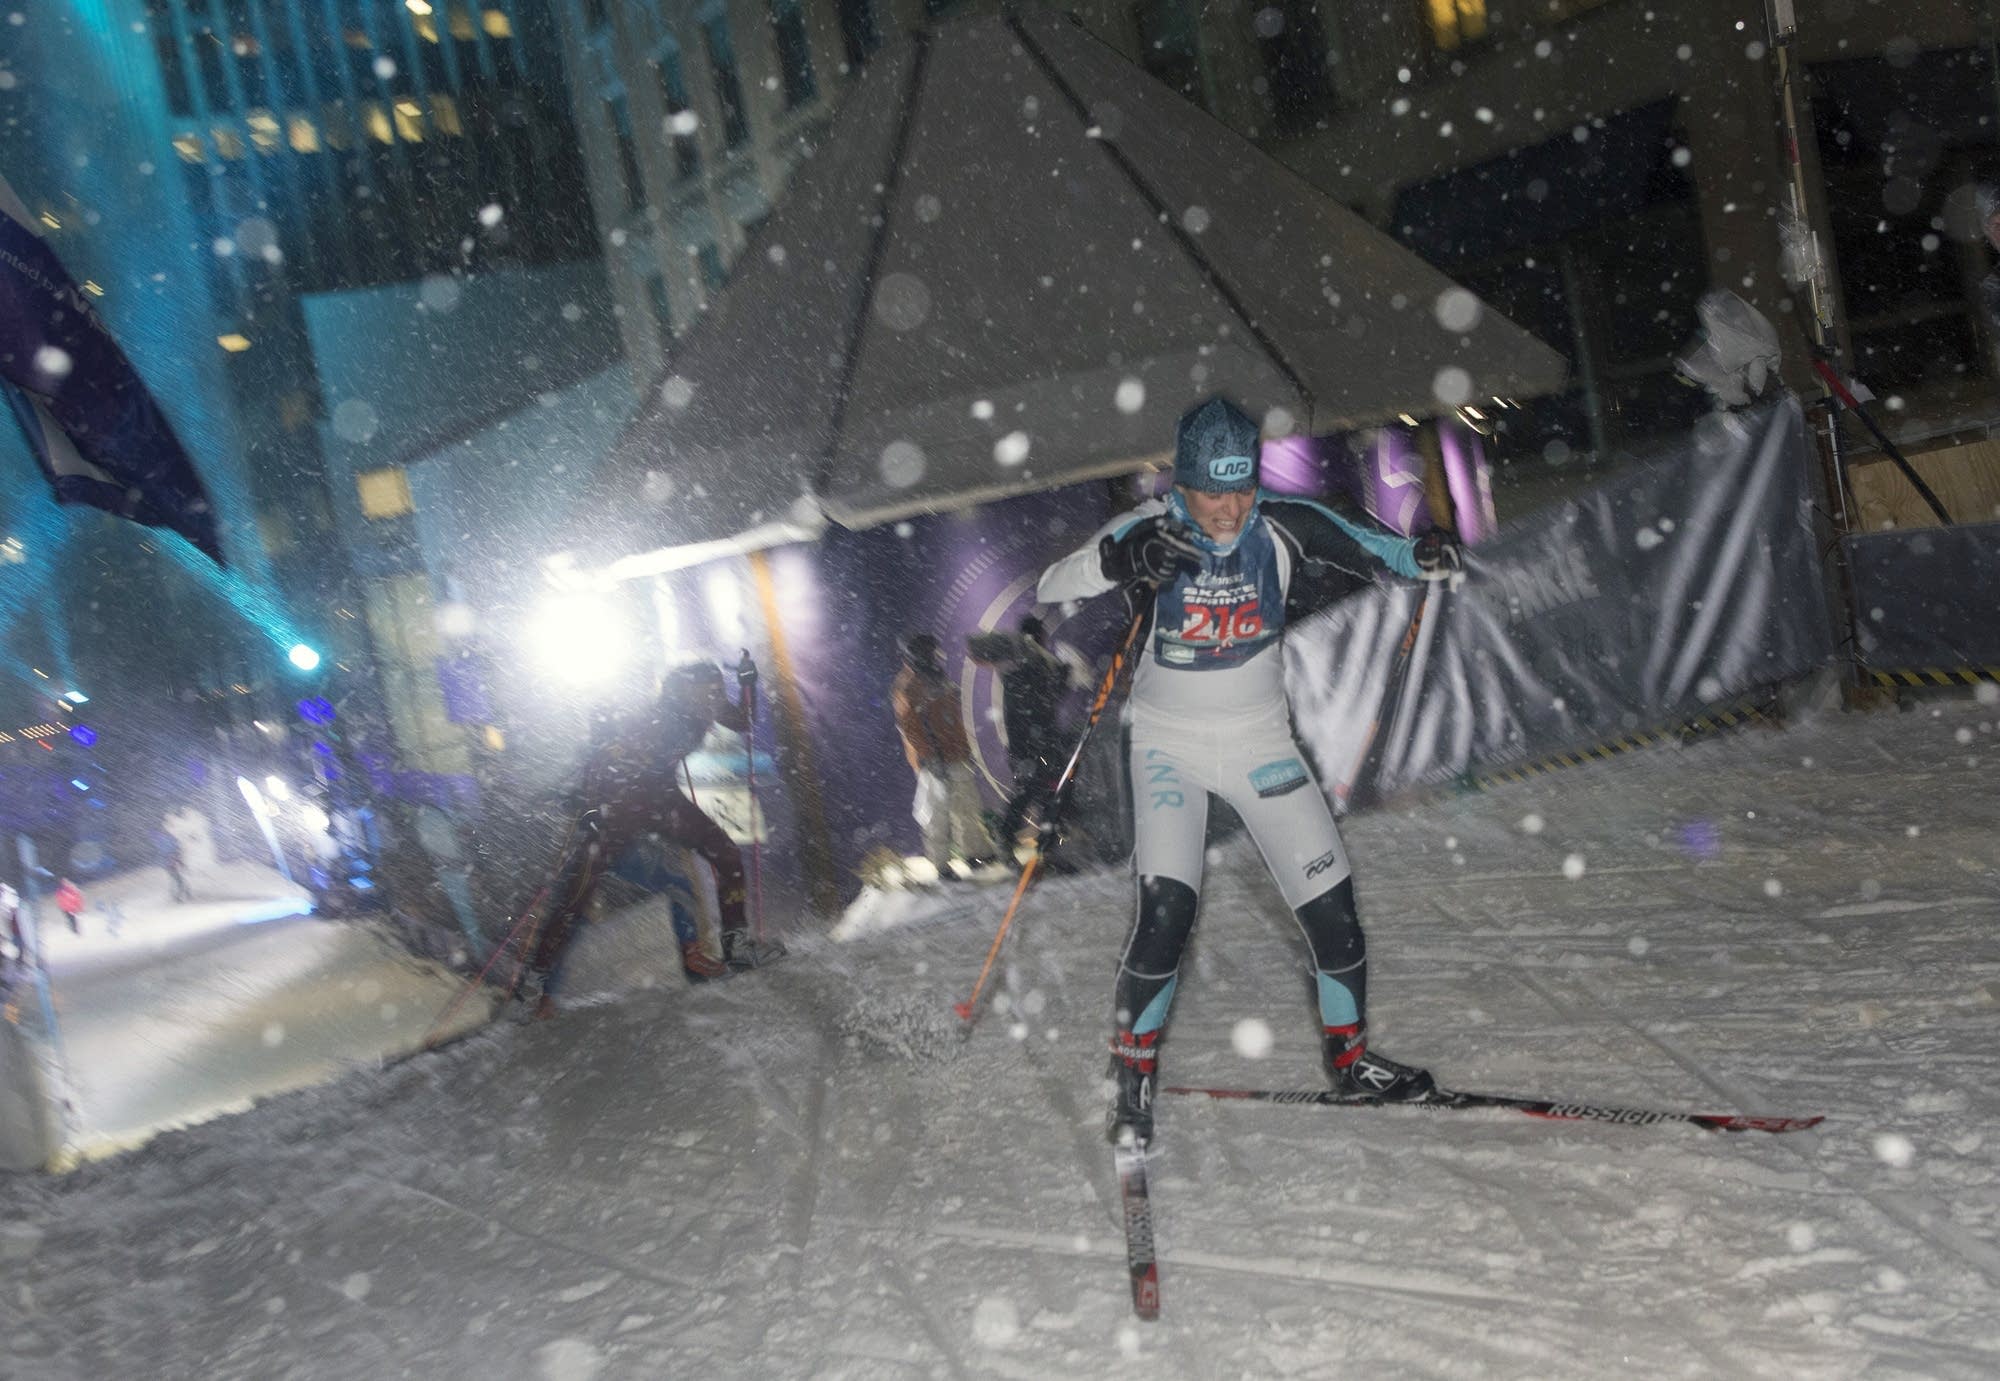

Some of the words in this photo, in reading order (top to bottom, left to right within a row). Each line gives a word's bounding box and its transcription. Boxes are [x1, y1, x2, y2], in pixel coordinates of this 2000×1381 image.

[0, 249, 40, 281] nted
[1183, 584, 1256, 597] SKATE
[1183, 592, 1259, 605] SPRINTS
[1181, 599, 1263, 641] 216
